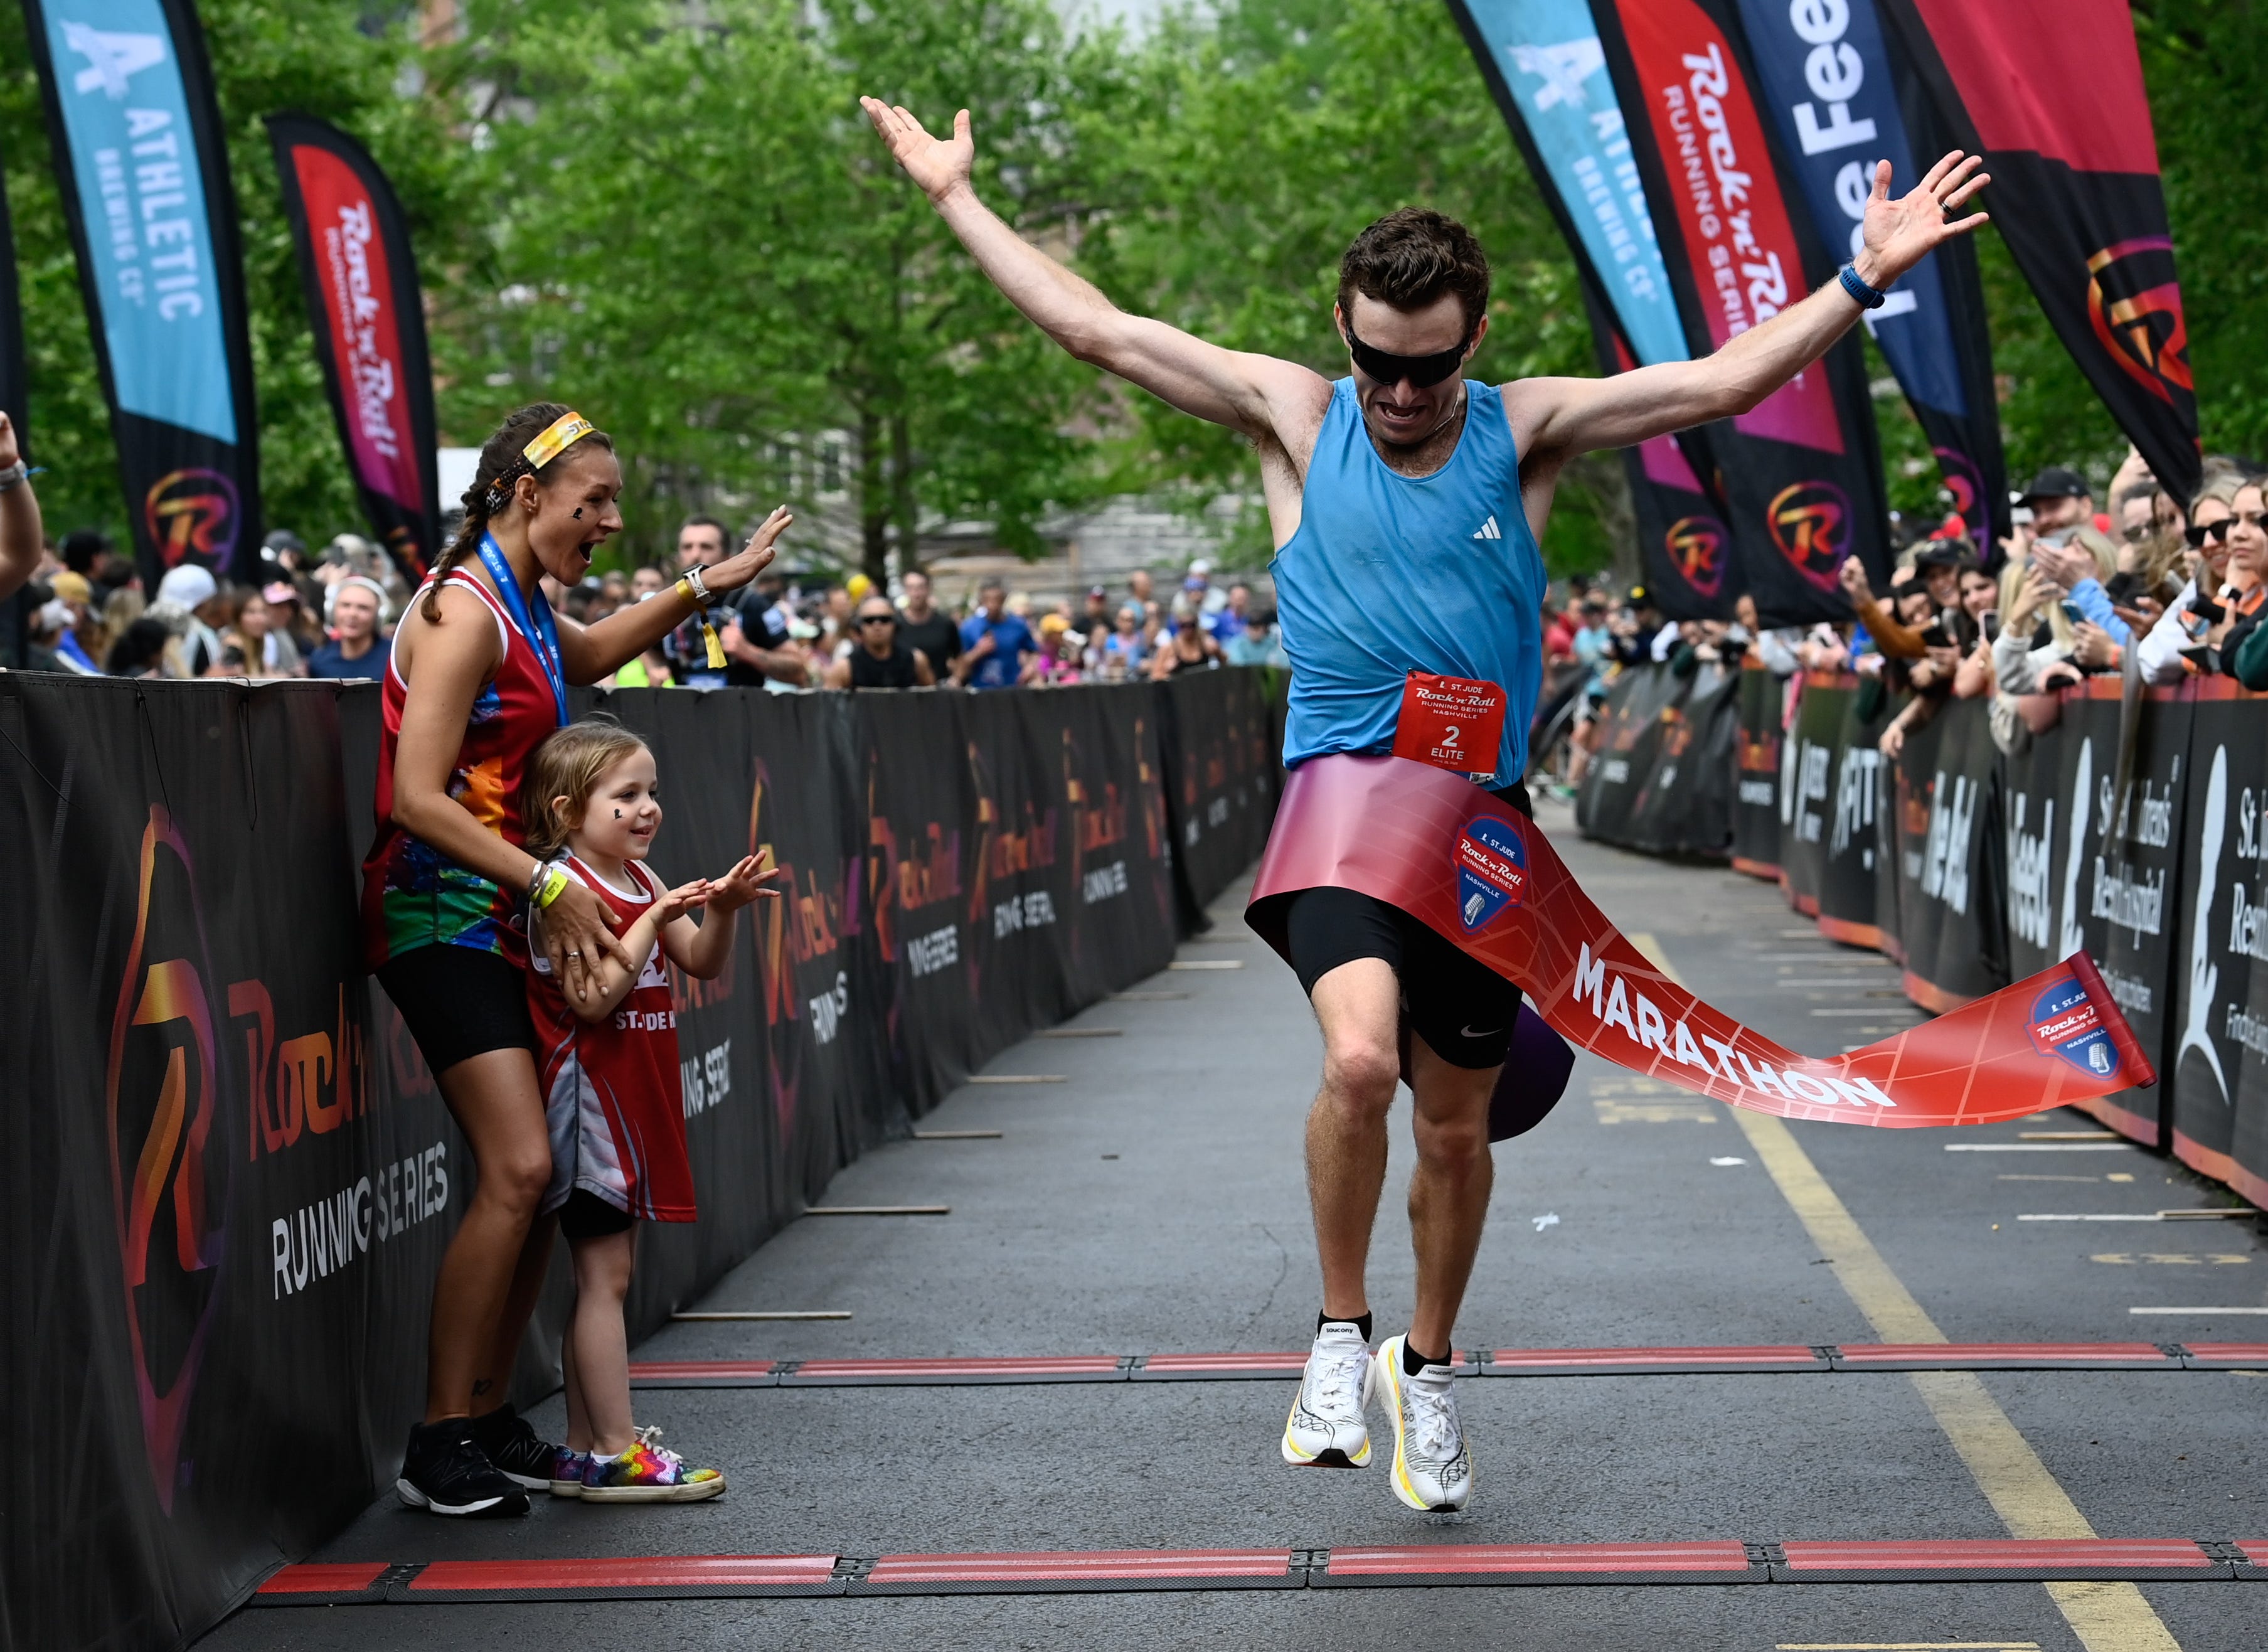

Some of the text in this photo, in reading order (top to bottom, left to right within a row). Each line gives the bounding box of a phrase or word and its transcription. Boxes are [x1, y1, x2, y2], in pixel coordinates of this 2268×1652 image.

[1790, 0, 1878, 156] Fee
[1682, 41, 1752, 211] Rock
[1663, 85, 1722, 239] RUNNING
[124, 108, 203, 321] ATHLETIC
[1462, 685, 1484, 694] JUDE
[1421, 700, 1459, 710] RUNNING
[1433, 709, 1478, 719] NASHVILLE
[1441, 725, 1461, 747] 2
[1430, 747, 1464, 760] ELITE
[1490, 839, 1516, 859] ST. JUDE
[1462, 854, 1514, 890] RUNNING SERIES
[1466, 873, 1500, 898] NASHVILLE
[615, 1010, 643, 1030] ST.
[1572, 941, 1897, 1107] MARATHON
[2049, 1023, 2087, 1042] RUNNING
[2067, 1028, 2107, 1050] NASHVILL
[376, 1141, 448, 1243] SERIES
